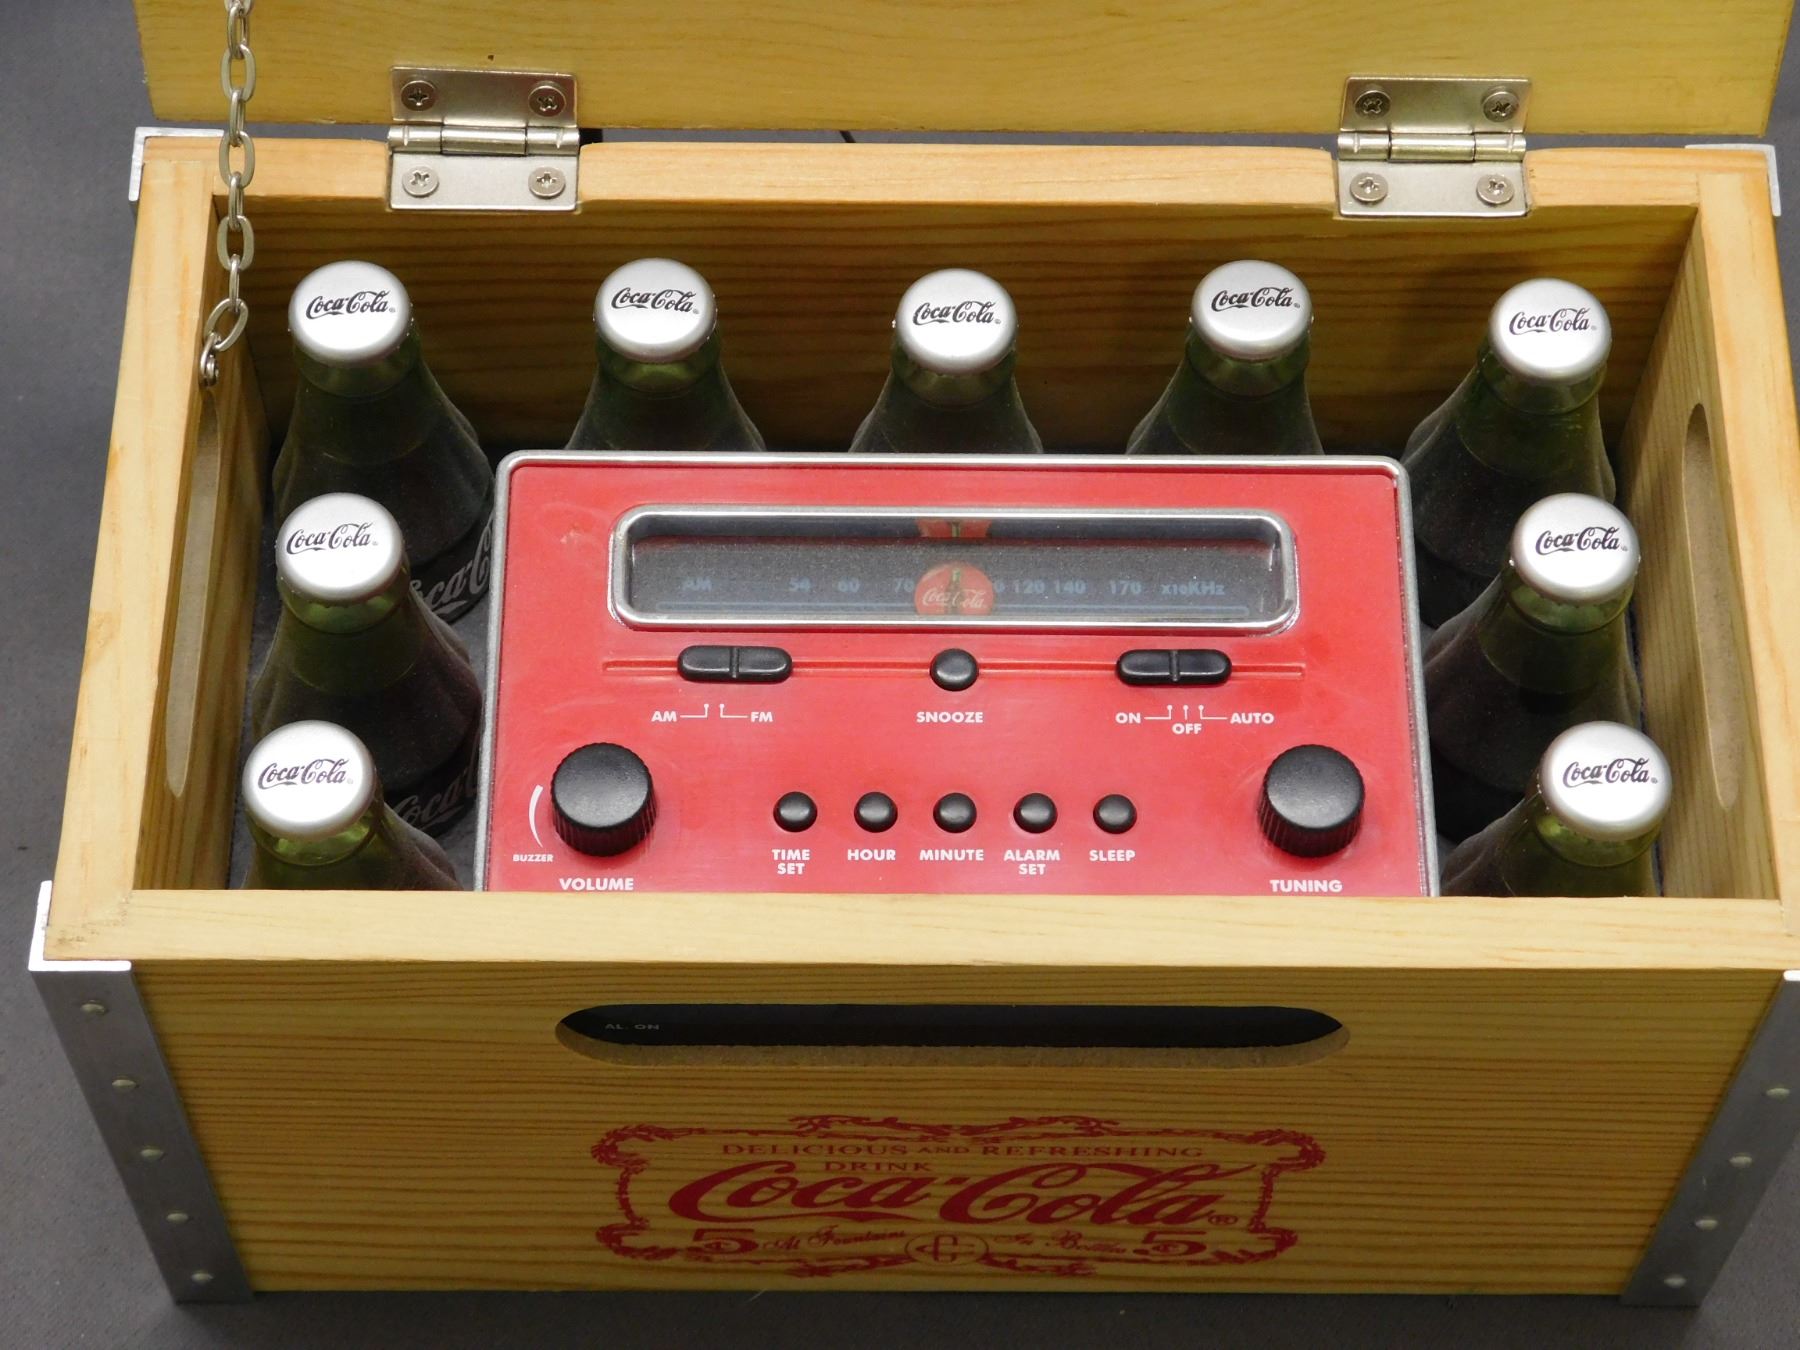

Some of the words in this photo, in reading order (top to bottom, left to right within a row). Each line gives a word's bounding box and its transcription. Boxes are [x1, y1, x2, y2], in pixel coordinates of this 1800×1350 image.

[681, 577, 713, 592] AM
[837, 577, 860, 592] 60
[894, 578, 915, 593] 70
[1013, 580, 1045, 595] 120
[1054, 580, 1086, 595] 140
[1110, 580, 1142, 595] 170
[650, 711, 677, 722] AM
[751, 711, 773, 722] FM
[916, 711, 984, 724] SNOOZE
[1115, 712, 1142, 724] ON
[1229, 712, 1274, 724] AUTO
[1172, 723, 1202, 735] OFF
[512, 854, 554, 863] BUZZER
[772, 849, 810, 861] TIME
[847, 849, 896, 861] HOUR
[919, 849, 984, 861] MINUTE
[1004, 849, 1060, 861] ALARM
[1089, 850, 1135, 862] SLEEP
[777, 862, 805, 875] SET
[1018, 863, 1046, 875] SET
[559, 878, 635, 890] VOLUME
[1269, 879, 1343, 893] TUNING
[723, 1144, 908, 1156] DELICIOUS
[919, 1145, 970, 1155] AND
[981, 1145, 1203, 1158] REFRESHING
[824, 1161, 933, 1172] DRINK
